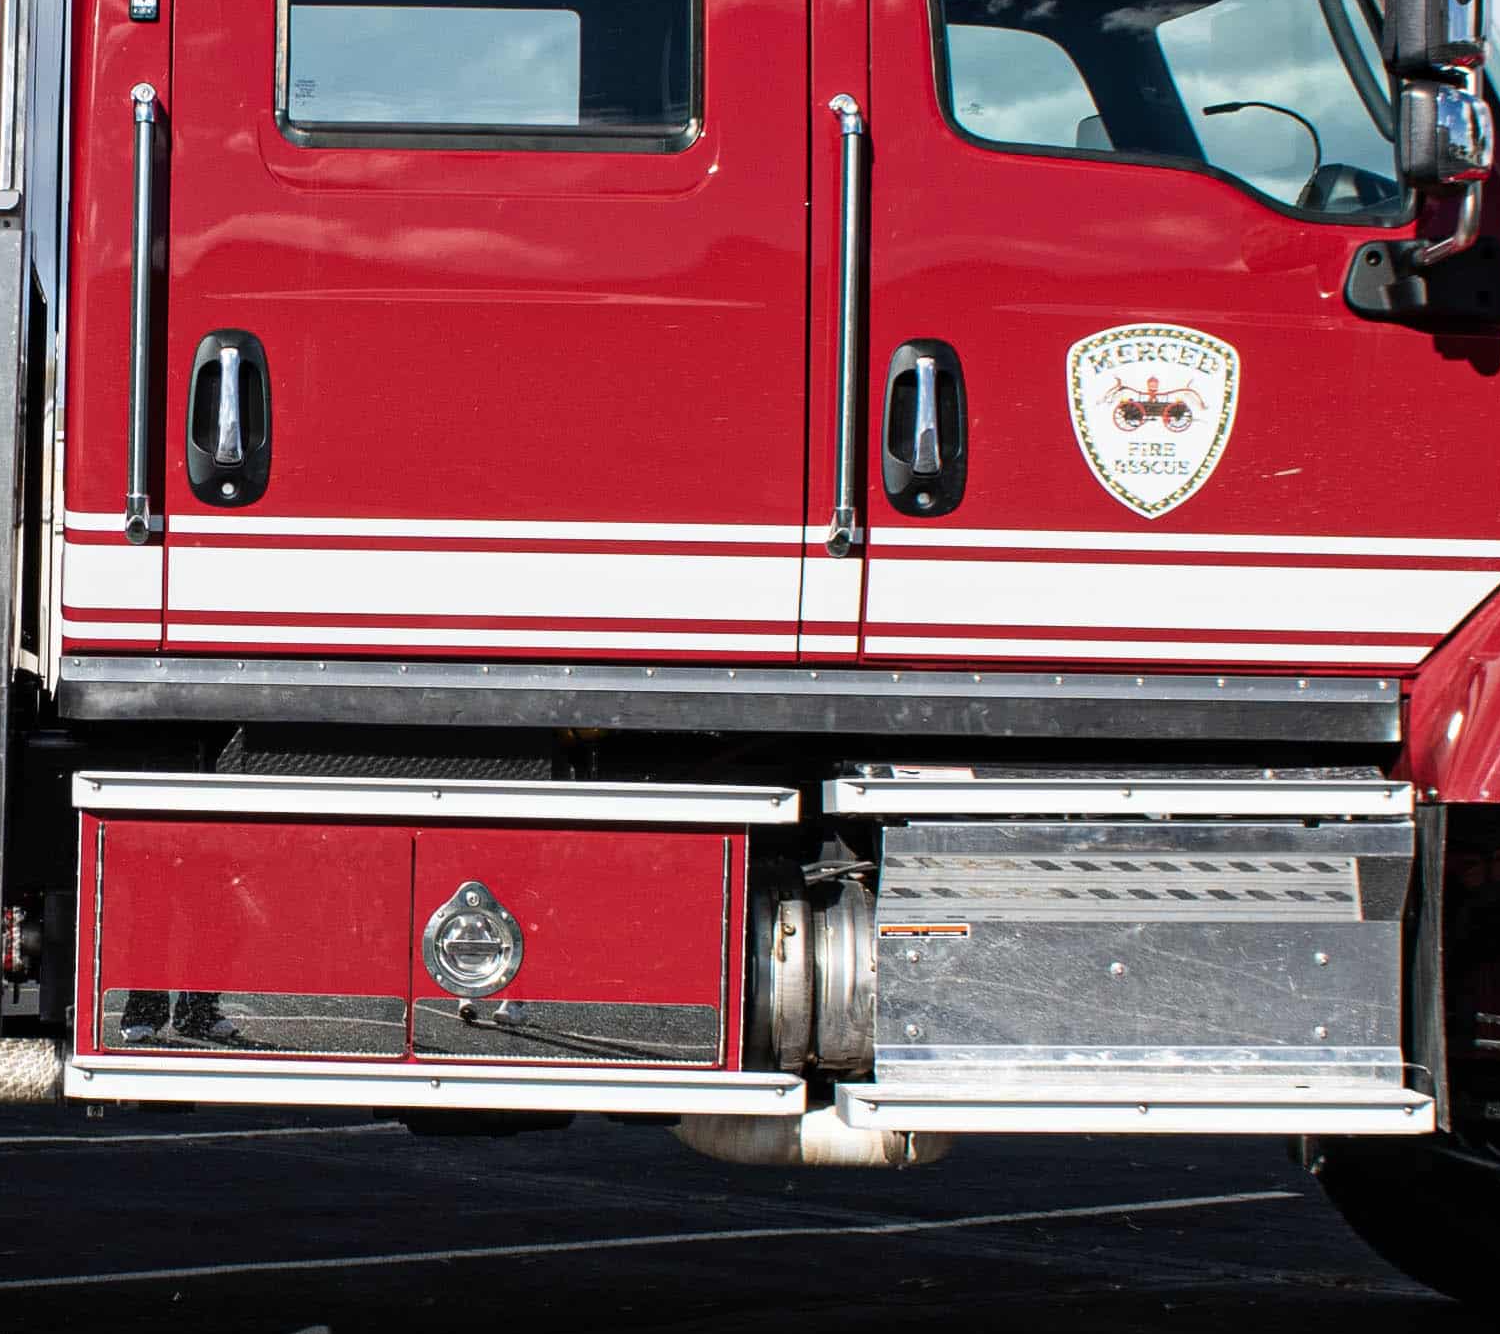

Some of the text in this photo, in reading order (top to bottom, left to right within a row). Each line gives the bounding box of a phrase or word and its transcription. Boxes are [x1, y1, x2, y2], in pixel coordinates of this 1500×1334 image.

[1088, 341, 1220, 374] MERCED
[1127, 442, 1177, 457] FIRE
[1113, 458, 1191, 475] RESCUE
